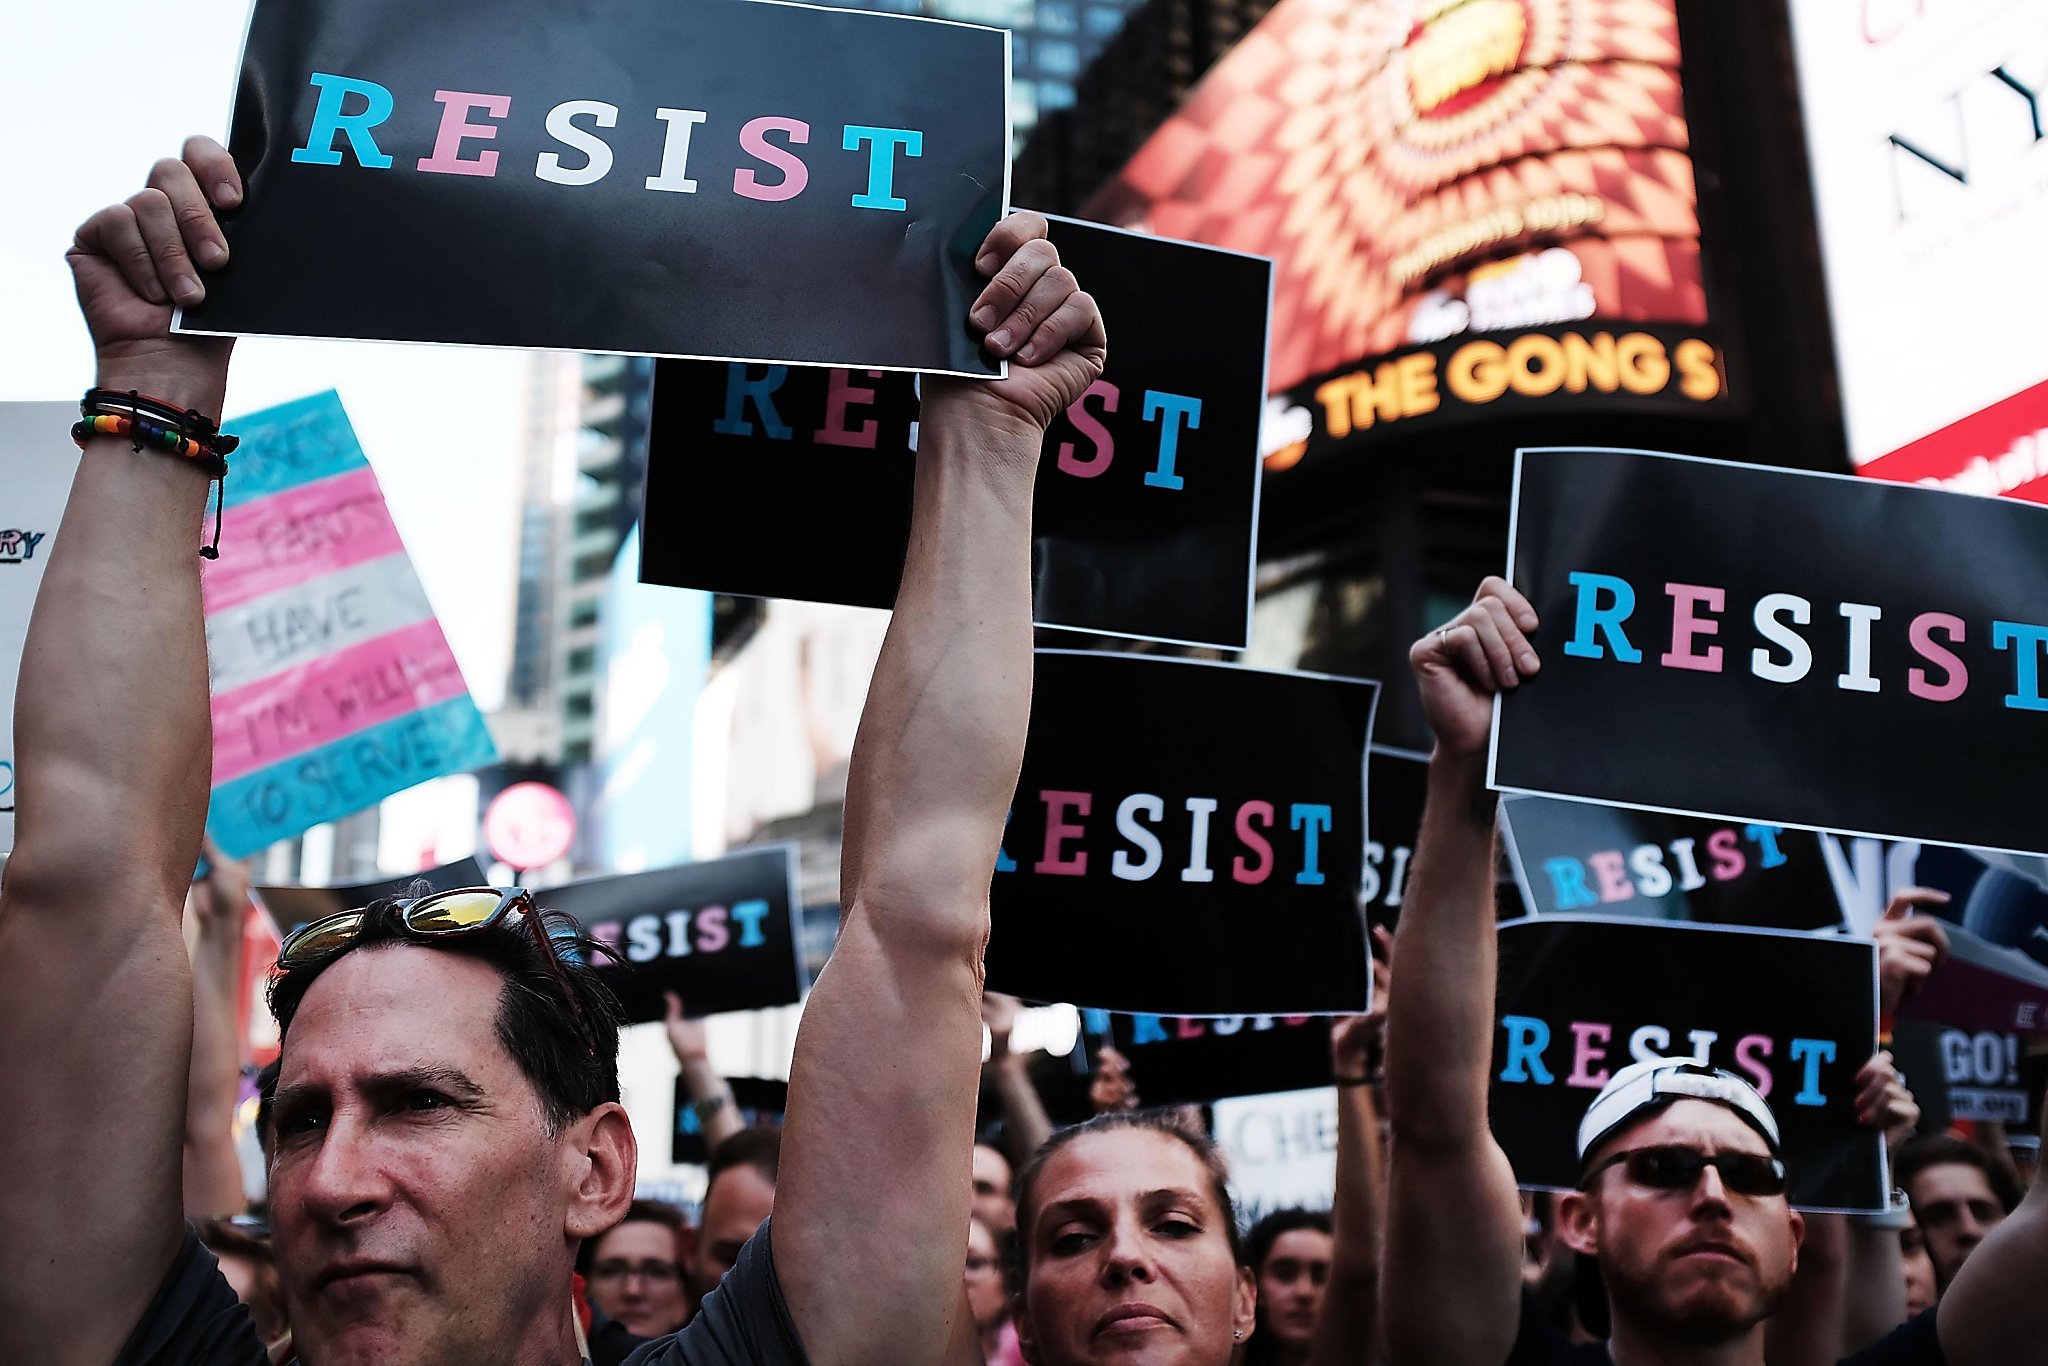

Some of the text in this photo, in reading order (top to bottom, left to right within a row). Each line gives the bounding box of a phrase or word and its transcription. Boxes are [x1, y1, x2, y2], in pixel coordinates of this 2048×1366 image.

[291, 72, 924, 211] RESIST
[713, 362, 1202, 490] REST
[1315, 351, 1440, 439] THE
[1446, 331, 1671, 404] GONG
[246, 584, 364, 657] HAVE
[243, 716, 442, 833] TO SERVE
[1542, 824, 1788, 911] RESIST
[1940, 1030, 2019, 1084] GO!
